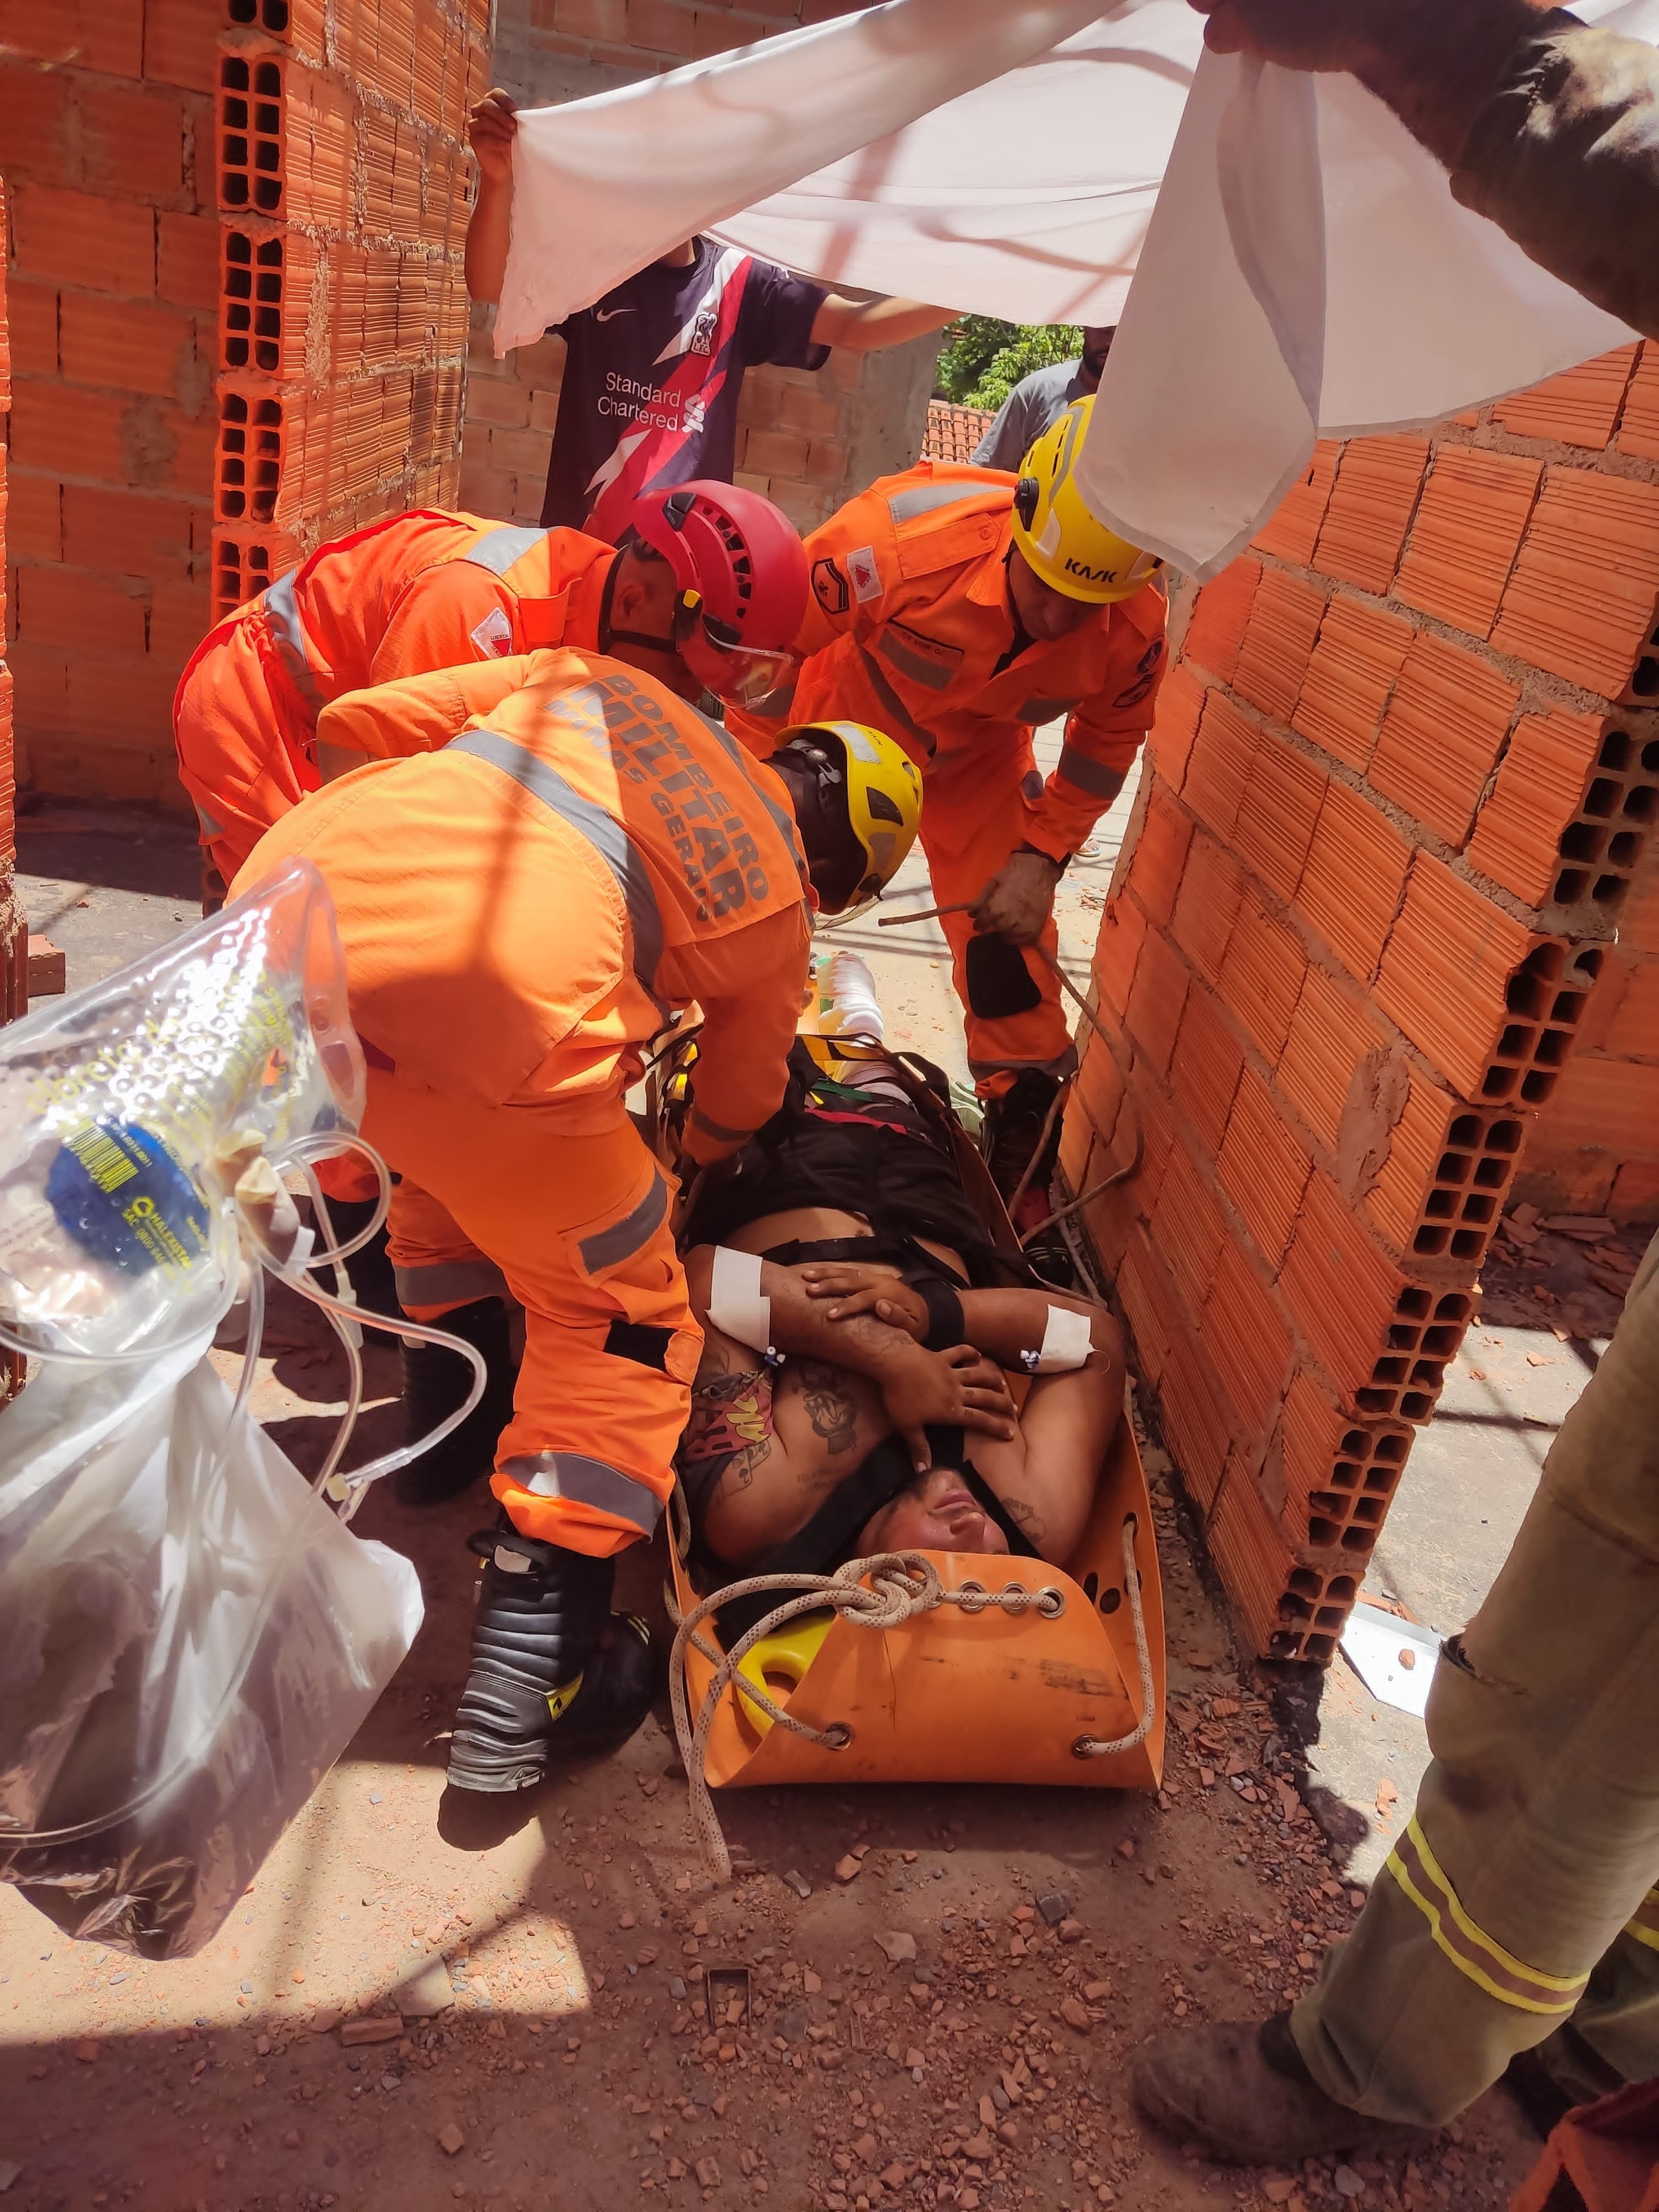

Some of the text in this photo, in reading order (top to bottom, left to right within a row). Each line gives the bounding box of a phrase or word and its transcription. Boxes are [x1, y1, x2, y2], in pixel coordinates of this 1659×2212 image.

[693, 342, 709, 354] LFC
[606, 372, 681, 408] Standard
[597, 395, 678, 432] Chartered
[1064, 557, 1118, 584] KASK
[544, 698, 648, 784] MINAS
[566, 681, 745, 917] MILITAR
[602, 674, 769, 901] BOMBEIRO
